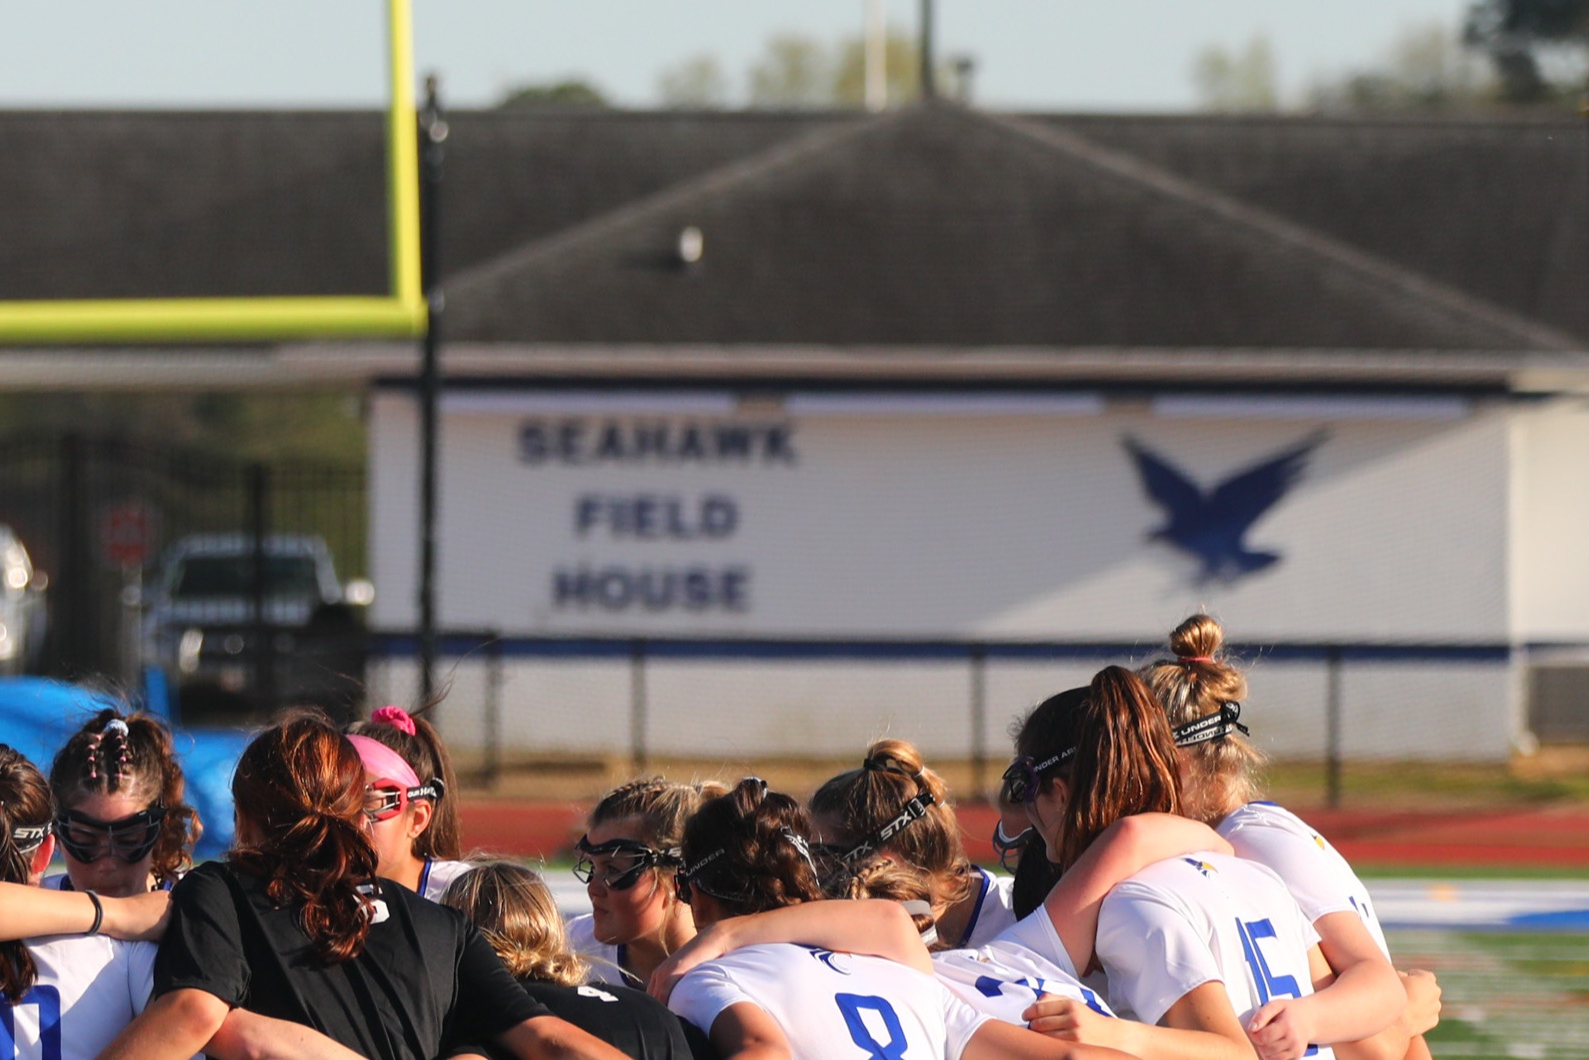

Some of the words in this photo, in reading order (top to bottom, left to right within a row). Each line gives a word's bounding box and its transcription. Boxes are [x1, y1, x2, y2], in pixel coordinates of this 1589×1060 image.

[517, 420, 800, 464] SEAHAWK
[575, 492, 740, 540] FIELD
[551, 566, 752, 611] HOUSE
[1181, 715, 1221, 736] UNDER
[13, 827, 45, 839] STX
[880, 811, 912, 841] STX
[686, 848, 726, 877] UNDER
[1234, 916, 1319, 1058] 15
